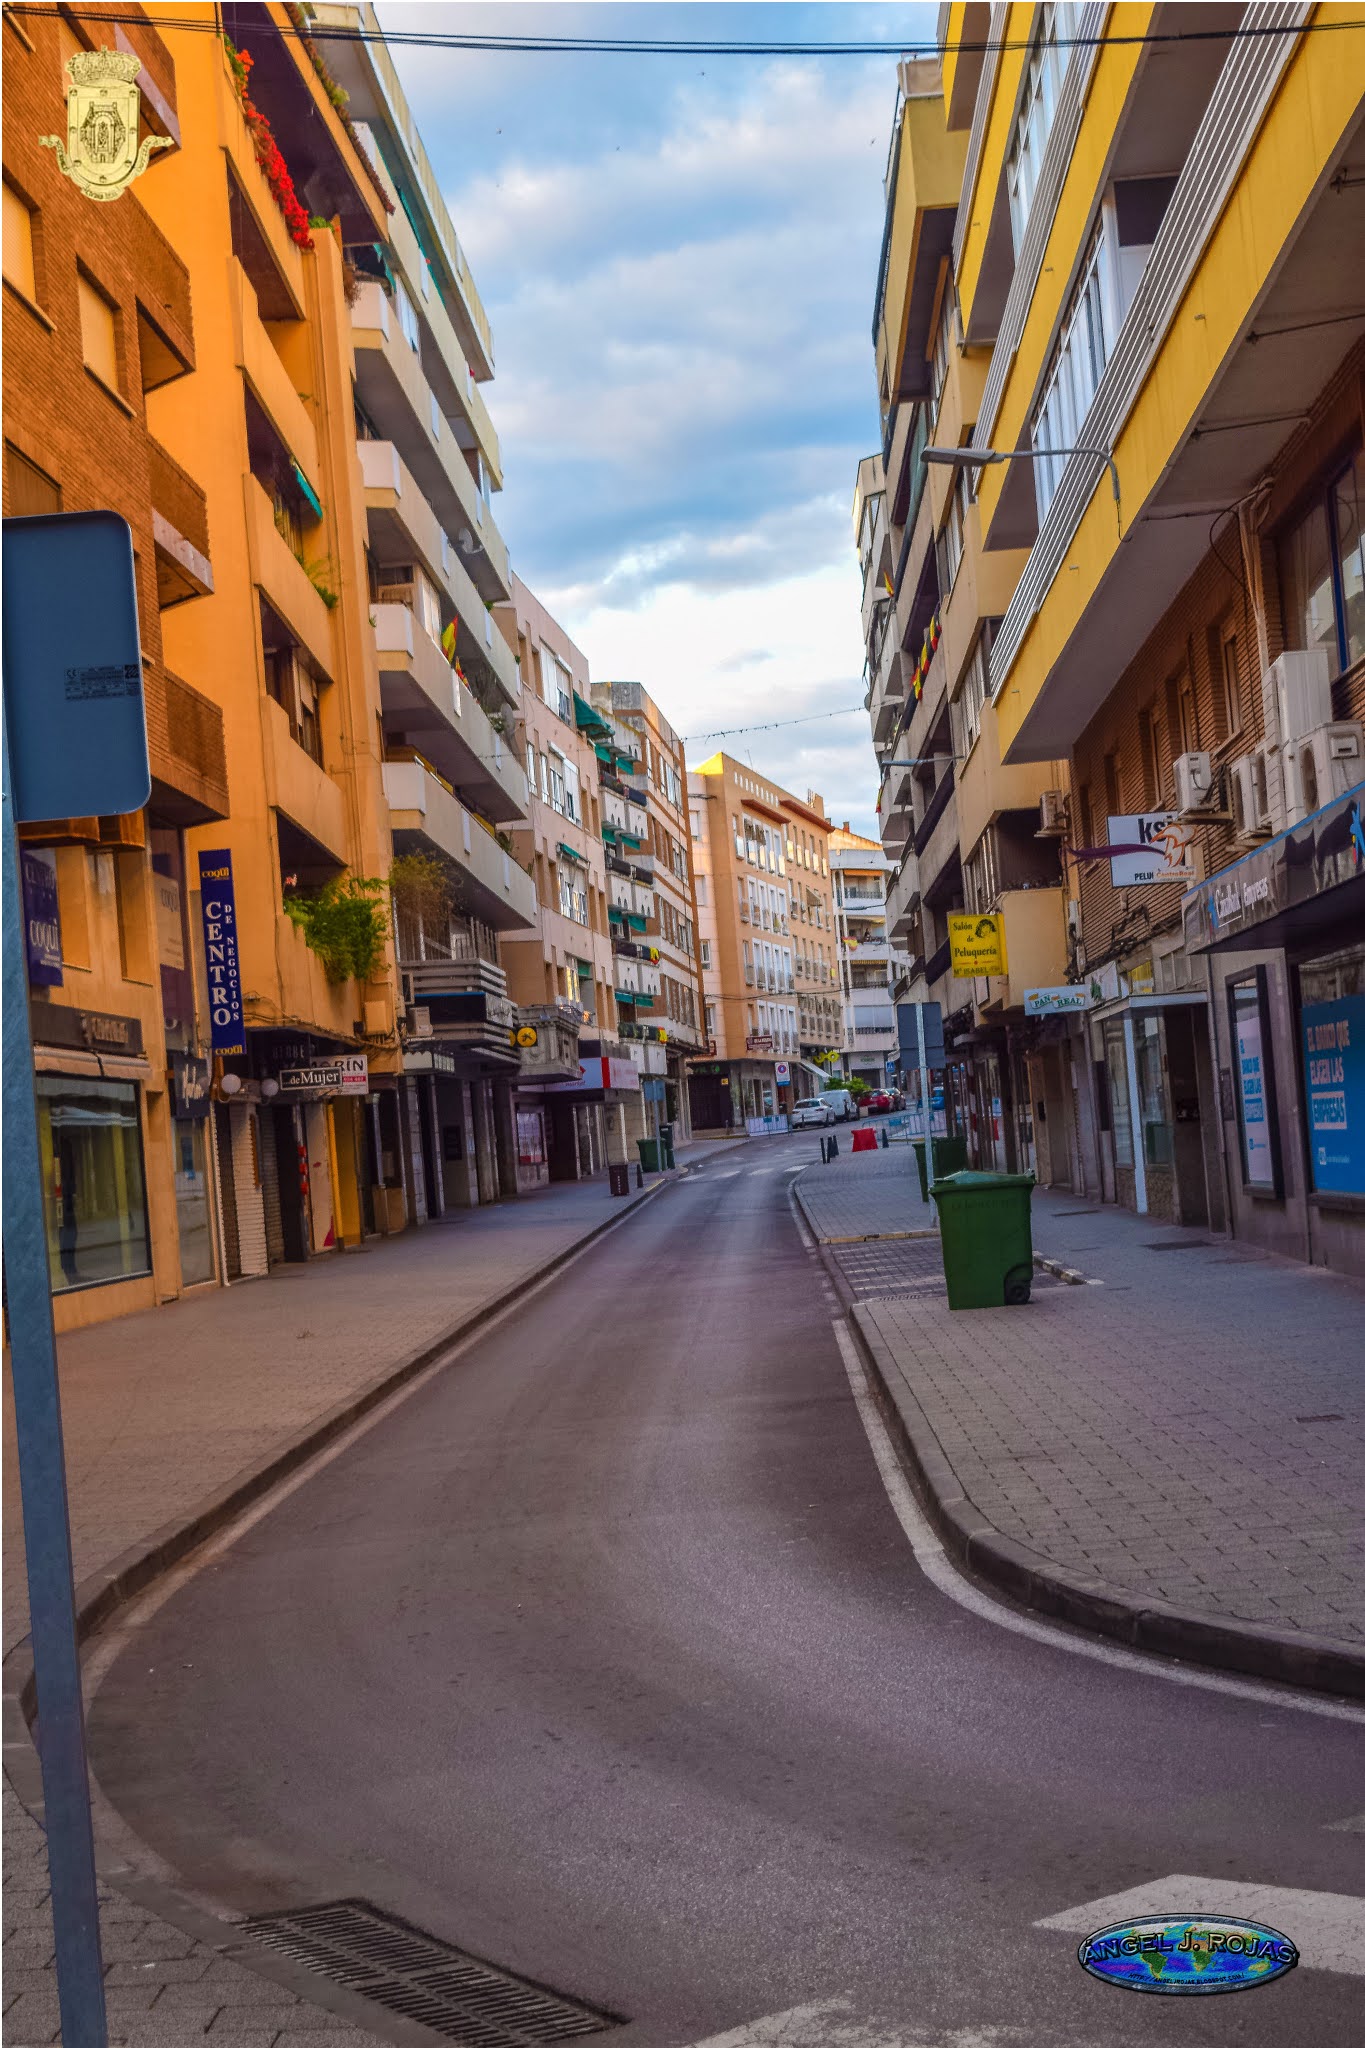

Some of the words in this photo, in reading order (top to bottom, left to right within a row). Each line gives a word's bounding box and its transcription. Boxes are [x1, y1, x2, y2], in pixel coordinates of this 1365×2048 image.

[224, 904, 233, 924] DE
[953, 921, 973, 931] Salón
[966, 935, 974, 943] de
[954, 945, 998, 959] Peluquería
[206, 902, 231, 1026] CENTRO
[963, 966, 989, 975] ISABEL
[226, 937, 240, 1021] NEGOCIOS
[1034, 995, 1051, 1008] PAN
[1056, 998, 1082, 1008] REAL
[301, 1070, 339, 1086] Mujer
